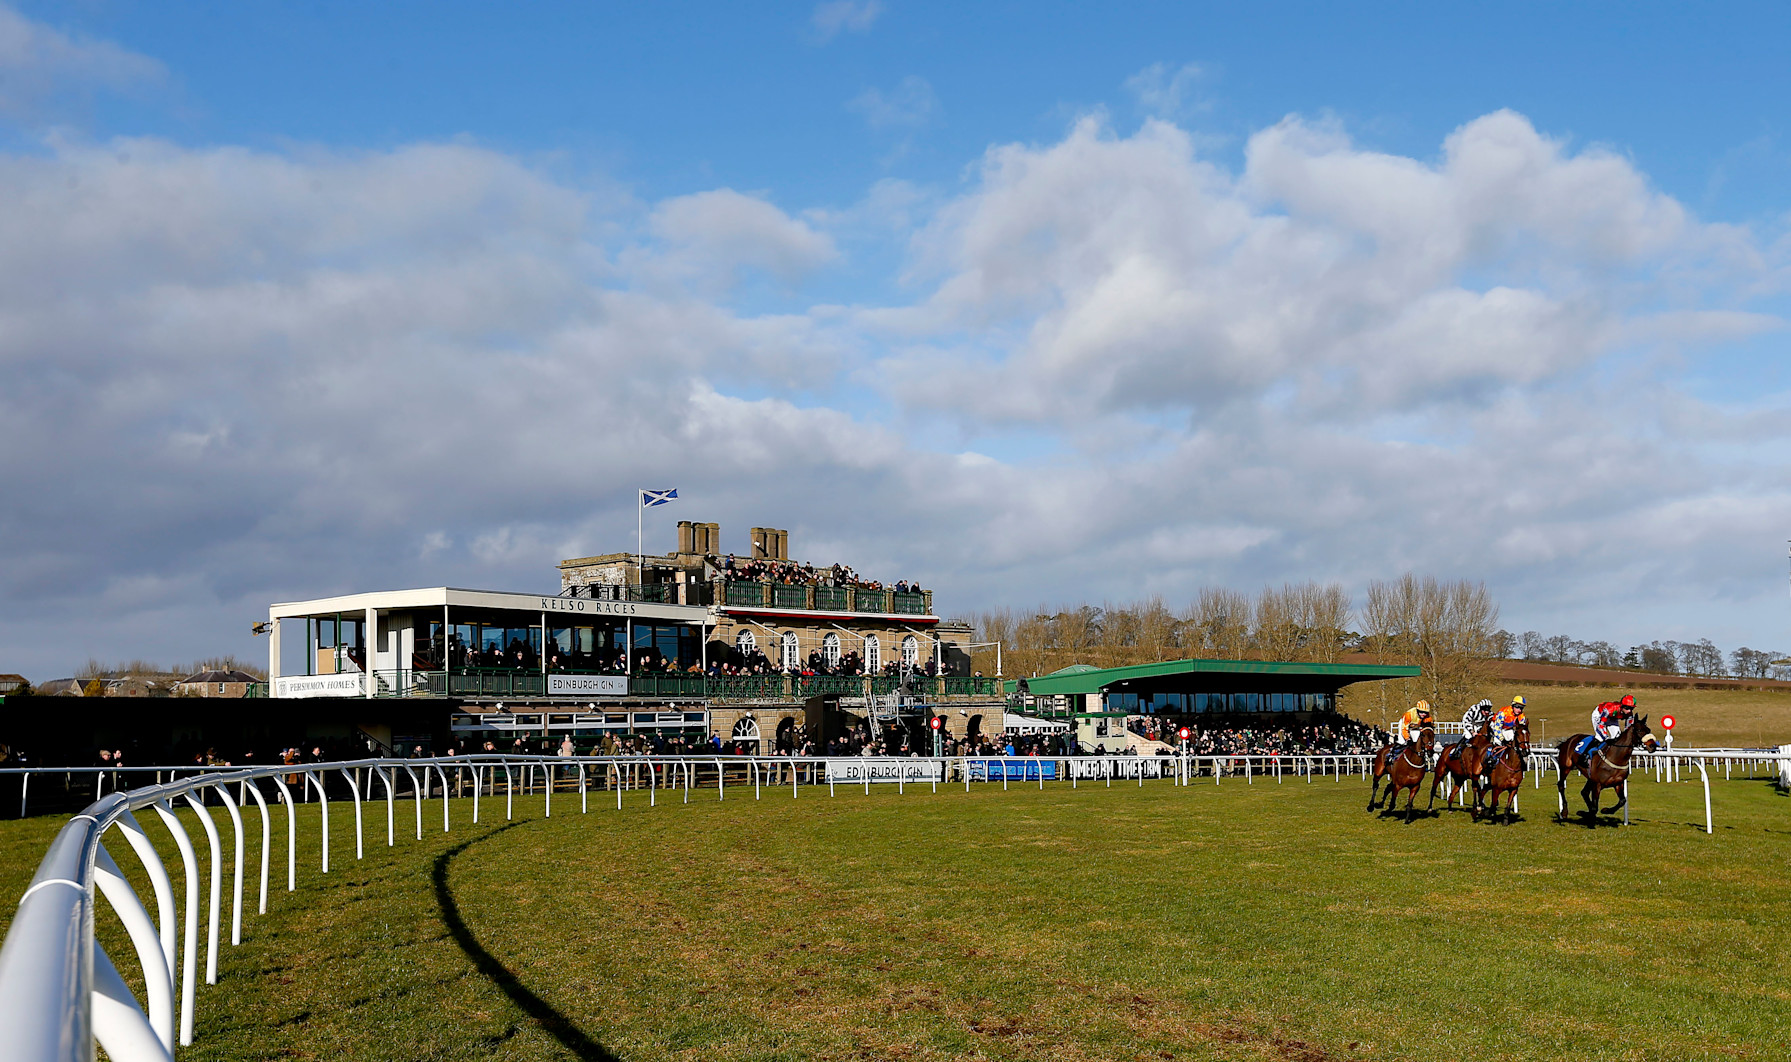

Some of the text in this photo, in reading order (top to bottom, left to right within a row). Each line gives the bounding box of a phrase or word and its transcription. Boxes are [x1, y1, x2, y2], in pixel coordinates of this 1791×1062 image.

[541, 598, 636, 614] KELSO RACES
[290, 680, 356, 692] PERSIMMON HOMES
[553, 679, 599, 689] EDINBURGH
[600, 680, 614, 689] GIN
[1575, 741, 1584, 751] 2
[907, 766, 923, 777] GIN
